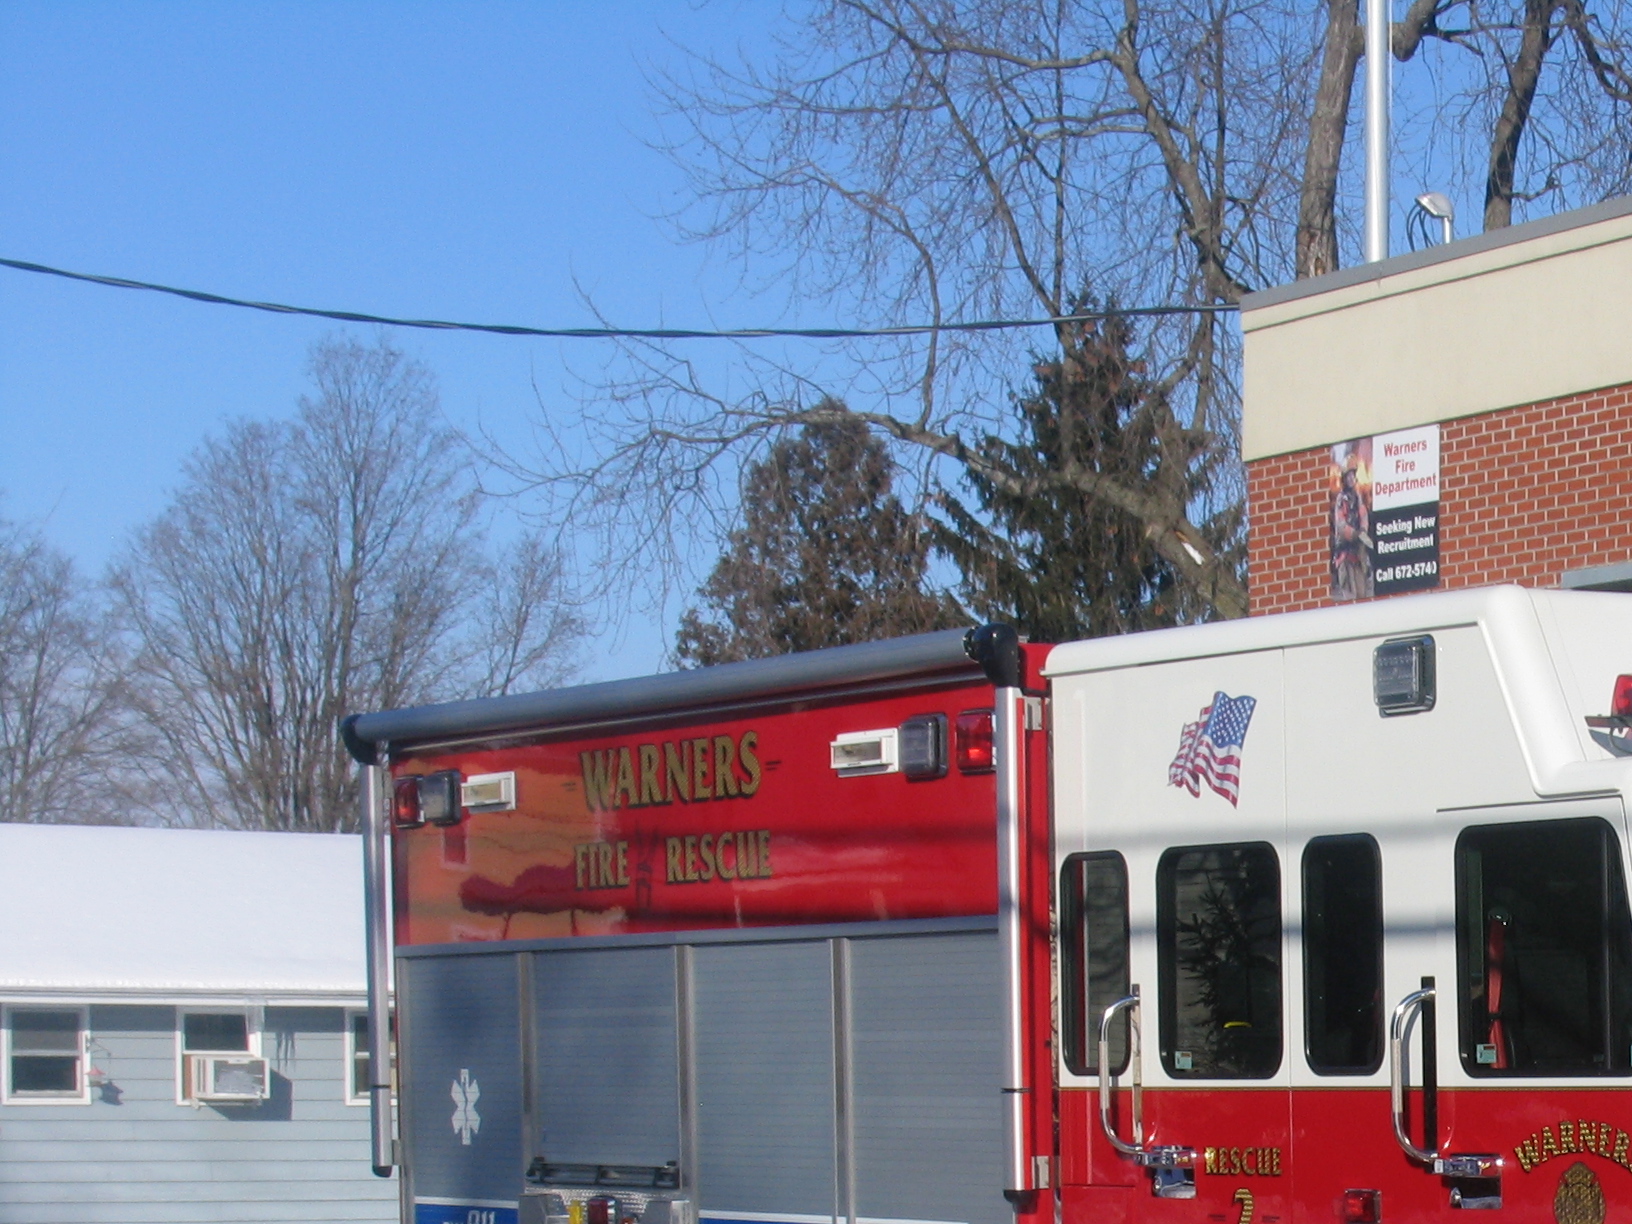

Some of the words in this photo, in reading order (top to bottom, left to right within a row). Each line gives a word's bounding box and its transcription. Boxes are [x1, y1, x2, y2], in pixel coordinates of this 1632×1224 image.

[1383, 440, 1428, 457] Warners
[1395, 459, 1416, 474] Fire
[1375, 473, 1437, 497] Department
[1376, 519, 1413, 536] Seeking
[1414, 515, 1436, 530] New
[1377, 534, 1434, 554] Recruitment
[1376, 567, 1394, 582] Call
[580, 731, 762, 812] WARNERS
[574, 840, 630, 891] FIRE
[665, 829, 773, 885] RESCUE
[1204, 1146, 1282, 1177] RESCUE
